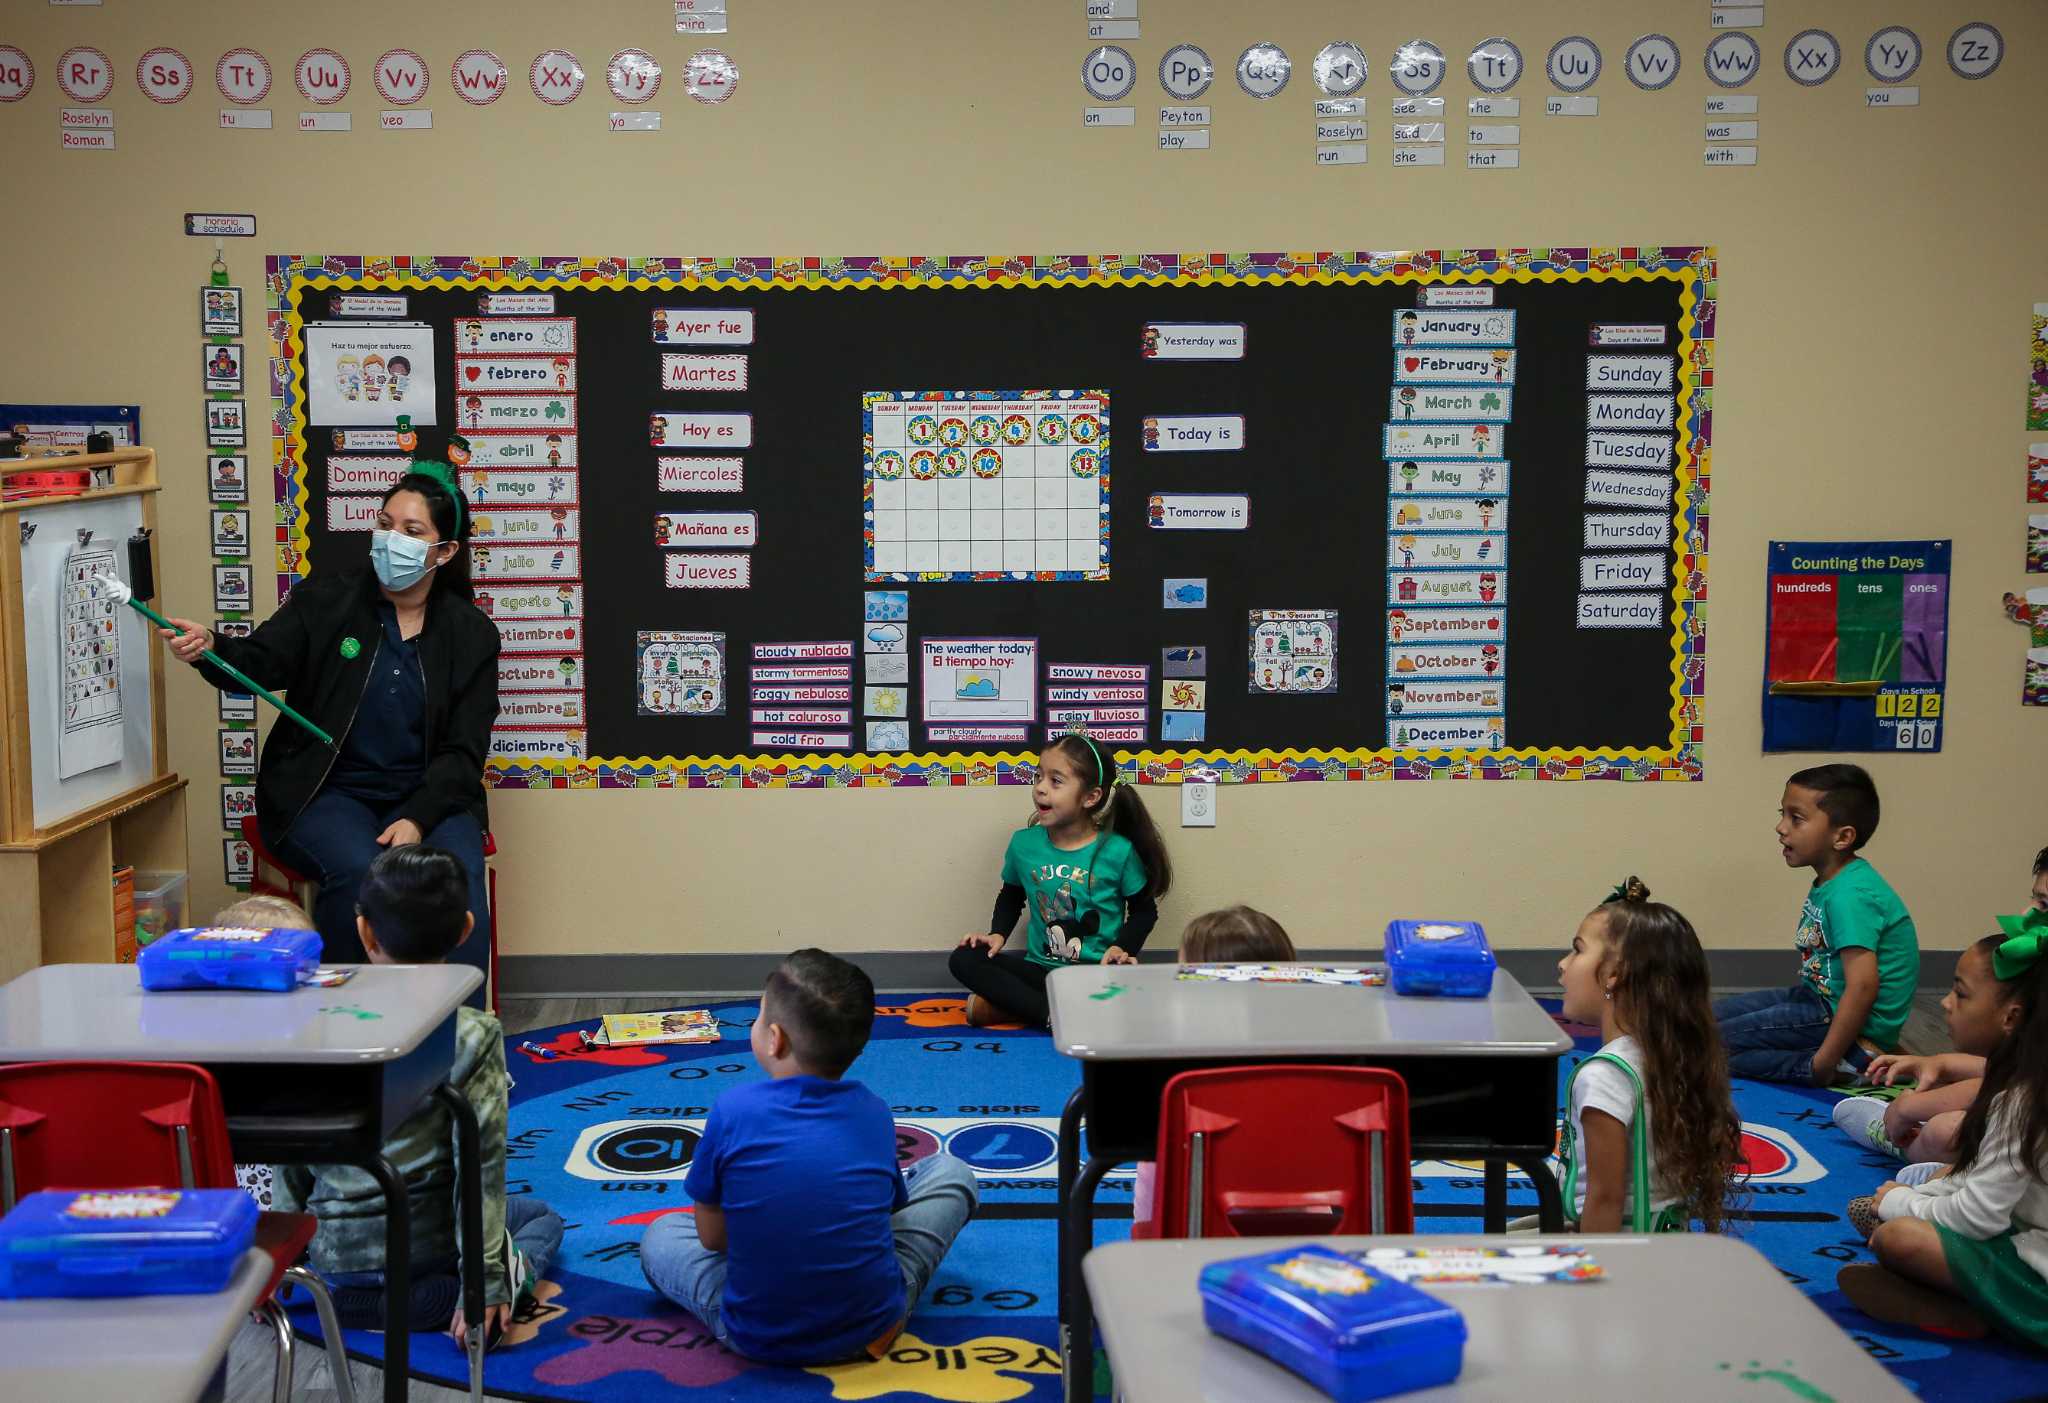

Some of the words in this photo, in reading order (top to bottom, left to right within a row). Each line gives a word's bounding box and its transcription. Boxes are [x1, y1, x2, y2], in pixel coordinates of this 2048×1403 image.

[1088, 2, 1110, 15] and
[1712, 13, 1724, 25] in
[1090, 25, 1104, 37] at
[1797, 48, 1828, 70] Xx
[1879, 44, 1910, 69] Yy
[1961, 41, 1990, 62] Zz
[1483, 57, 1507, 77] Tt
[1560, 54, 1589, 76] Uu
[1638, 53, 1668, 73] Vv
[1713, 50, 1754, 71] Ww
[71, 63, 100, 85] Rr
[151, 65, 180, 86] Ss
[229, 65, 256, 87] Tt
[306, 66, 338, 89] Uu
[385, 68, 417, 89] Vv
[459, 69, 500, 90] Ww
[541, 65, 573, 88] Xx
[618, 66, 648, 91] Yy
[697, 66, 726, 87] Zz
[1092, 62, 1124, 83] Oo
[1172, 61, 1201, 87] Pp
[1706, 100, 1725, 111] we
[1866, 91, 1890, 107] you
[1394, 103, 1416, 114] see
[1548, 102, 1562, 116] up
[62, 112, 109, 128] Roselyn
[221, 114, 235, 125] tu
[301, 116, 316, 128] un
[382, 115, 403, 127] veo
[610, 116, 625, 130] yo
[1086, 113, 1100, 124] on
[1161, 109, 1203, 127] Peyton
[63, 132, 105, 147] Roman
[1318, 126, 1363, 141] Roselyn
[1470, 129, 1483, 141] to
[1706, 126, 1731, 138] was
[1160, 133, 1185, 150] play
[1318, 151, 1339, 162] run
[1394, 151, 1417, 163] she
[1469, 153, 1497, 165] that
[1706, 149, 1734, 162] with
[203, 224, 245, 235] schedule
[675, 321, 711, 337] Ayer
[717, 320, 742, 335] fue
[1421, 320, 1481, 337] January
[490, 330, 534, 343] enero
[1163, 336, 1215, 348] Yesterday
[1219, 337, 1238, 346] was
[347, 342, 356, 350] tu
[357, 342, 378, 351] mejor
[487, 365, 547, 380] febrero
[1421, 357, 1489, 374] February
[672, 365, 737, 382] Martes
[1597, 365, 1663, 386] Sunday
[1425, 395, 1473, 409] March
[490, 405, 538, 418] marzo
[1596, 403, 1666, 424] Monday
[118, 426, 126, 440] 1
[682, 424, 711, 439] Hoy
[717, 425, 734, 436] es
[920, 424, 927, 437] 1
[949, 427, 957, 441] 2
[981, 424, 989, 438] 3
[1011, 425, 1020, 437] 4
[1048, 423, 1057, 436] 5
[1080, 423, 1089, 437] 6
[1168, 428, 1212, 443] Today
[1219, 427, 1230, 439] is
[1423, 433, 1460, 449] April
[499, 443, 535, 457] abril
[1592, 440, 1667, 462] Tuesday
[885, 458, 893, 471] 7
[920, 459, 929, 472] 8
[947, 456, 956, 470] 9
[980, 457, 995, 470] 10
[1080, 456, 1093, 470] 13
[663, 467, 738, 481] Miercoles
[1431, 470, 1462, 487] May
[496, 481, 536, 497] mayo
[1591, 480, 1668, 501] Wednesday
[1167, 506, 1226, 518] Tomorrow
[1231, 507, 1241, 518] is
[1428, 507, 1463, 521] June
[502, 519, 539, 535] junio
[675, 521, 727, 537] Mañana
[734, 524, 750, 536] es
[1590, 522, 1662, 542] Thursday
[1431, 543, 1462, 560] July
[502, 555, 535, 571] julio
[1791, 557, 1858, 571] Counting
[1862, 557, 1886, 569] the
[1889, 555, 1925, 570] Days
[675, 564, 737, 580] Jueves
[1594, 563, 1653, 583] Friday
[1420, 580, 1473, 597] August
[1776, 582, 1832, 593] hundreds
[1857, 583, 1883, 593] tens
[1909, 583, 1938, 593] ones
[499, 595, 552, 611] agosto
[1269, 611, 1286, 619] The
[1287, 611, 1319, 619] Seasons
[1581, 603, 1659, 623] Saturday
[1403, 617, 1488, 632] September
[756, 645, 797, 658] cloudy
[800, 645, 849, 656] nublado
[924, 643, 944, 654] The
[946, 643, 995, 654] weather
[998, 643, 1035, 656] today:
[933, 656, 943, 666] El
[945, 656, 987, 669] tiempo
[989, 656, 1014, 668] hoy:
[1414, 654, 1477, 668] October
[755, 668, 791, 679] stormy
[793, 668, 849, 678] tormentoso
[1052, 668, 1093, 680] snowy
[1097, 668, 1142, 679] nevoso
[753, 688, 791, 701] foggy
[794, 687, 849, 700] nebuloso
[1051, 689, 1089, 701] windy
[1093, 689, 1143, 700] ventoso
[1405, 688, 1482, 703] November
[763, 711, 783, 722] hot
[788, 712, 842, 723] caluroso
[1057, 711, 1090, 722] rainy
[1093, 709, 1140, 721] lluvioso
[933, 727, 956, 735] partly
[958, 727, 982, 735] cloudy
[1090, 728, 1138, 740] soleado
[1408, 726, 1485, 741] December
[493, 739, 565, 753] diciembre
[770, 734, 797, 745] cold
[801, 735, 825, 746] frio
[922, 1040, 1007, 1055] Qq
[669, 1064, 747, 1080] Oo
[628, 1106, 709, 1117] diez
[958, 1105, 1041, 1115] siete
[615, 1139, 684, 1160] 10
[969, 1134, 1024, 1160] 7
[601, 1182, 668, 1194] ten
[931, 1285, 1040, 1311] Gg
[888, 1347, 1063, 1371] Yello
